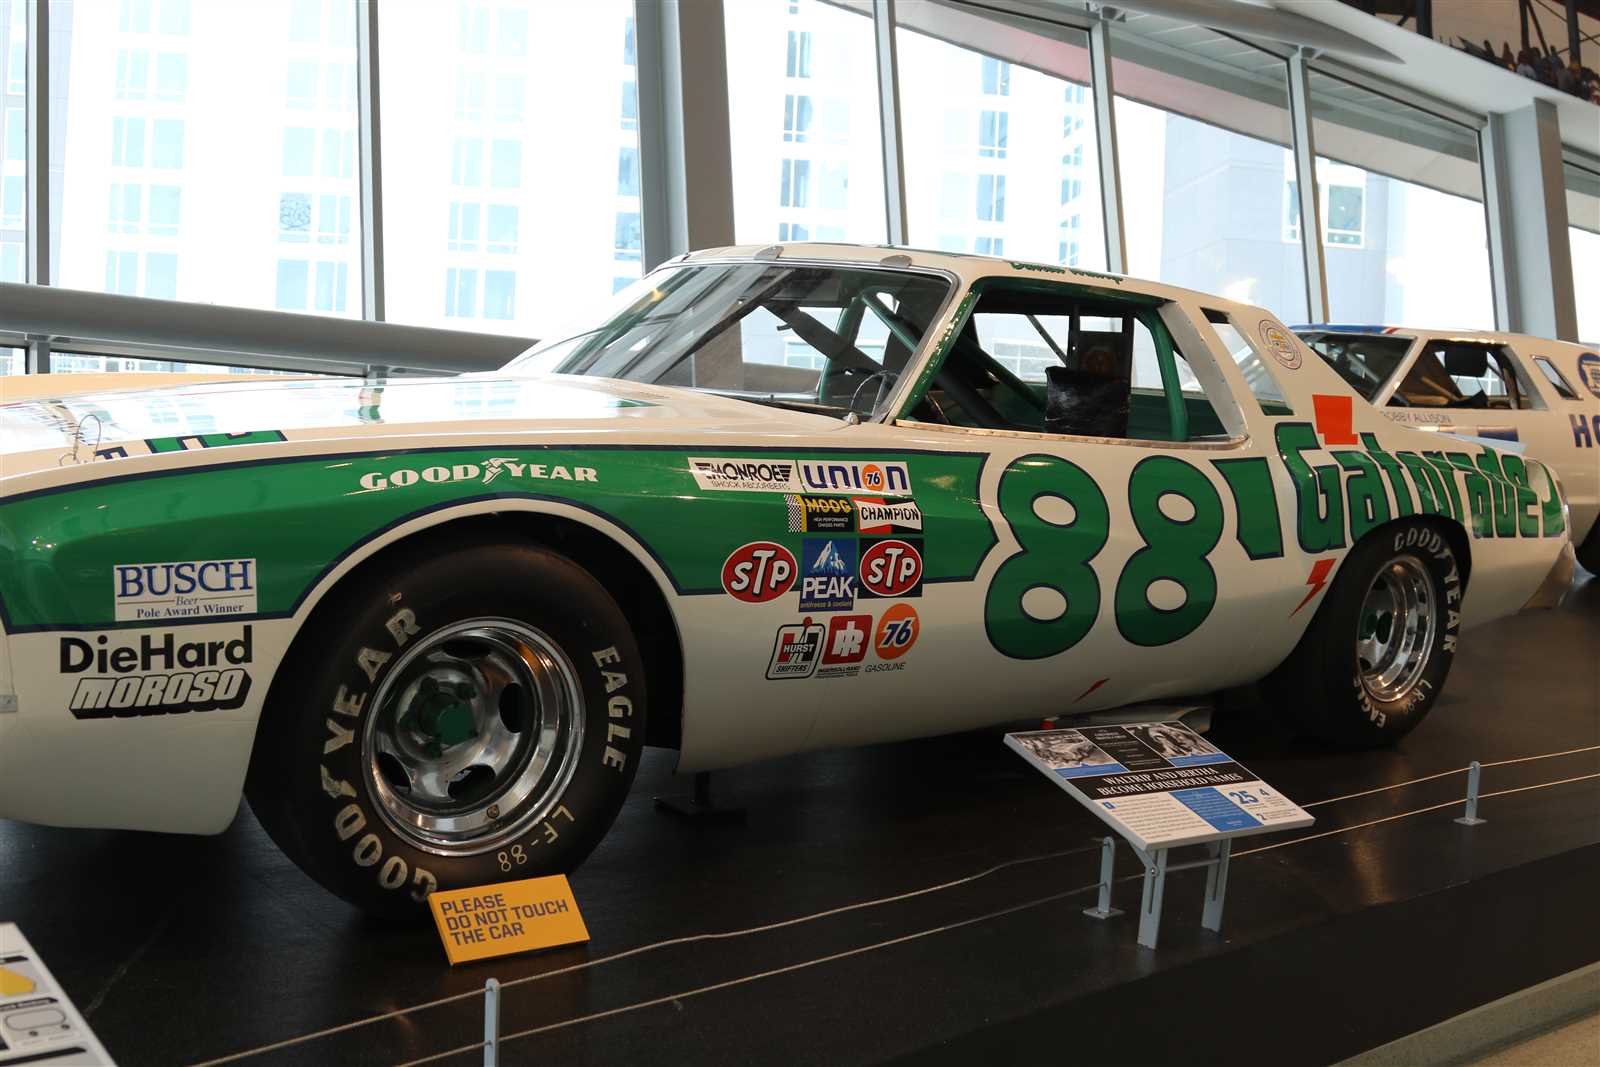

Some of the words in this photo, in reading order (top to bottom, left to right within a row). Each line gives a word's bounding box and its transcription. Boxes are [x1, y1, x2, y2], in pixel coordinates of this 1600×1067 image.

[703, 462, 787, 481] MONROE
[866, 472, 881, 486] 76
[1275, 422, 1540, 554] Gatorade
[805, 498, 851, 513] MOOG
[861, 506, 919, 521] CHAMPION
[867, 547, 917, 588] STP
[984, 453, 1225, 660] 88
[116, 560, 254, 598] BUSCH
[731, 549, 791, 595] STP
[802, 576, 854, 599] PEAK
[137, 608, 161, 618] Pole
[163, 606, 200, 617] Award
[203, 603, 244, 614] Winner
[176, 596, 198, 606] Beer
[879, 617, 912, 646] 76
[59, 624, 253, 674] DieHard
[784, 643, 815, 653] HURST
[775, 664, 809, 673] SHIFTERS
[864, 662, 906, 673] GASOLINE
[69, 668, 253, 720] MOROSO
[592, 645, 634, 773] EAGLE
[1096, 784, 1145, 796] BECOME
[1145, 778, 1208, 791] HOUSEHOLD
[1207, 773, 1244, 784] NAMES
[1102, 774, 1152, 785] WALTRIP
[1154, 772, 1178, 781] AND
[1178, 767, 1219, 778] BERTHA
[1229, 790, 1259, 805] 25
[1259, 788, 1270, 796] 4
[440, 893, 506, 916] PLEASE
[445, 914, 473, 932] DO
[475, 907, 511, 926] NOT
[513, 899, 569, 920] TOUCH
[450, 928, 487, 947] THE
[489, 921, 525, 941] CAR
